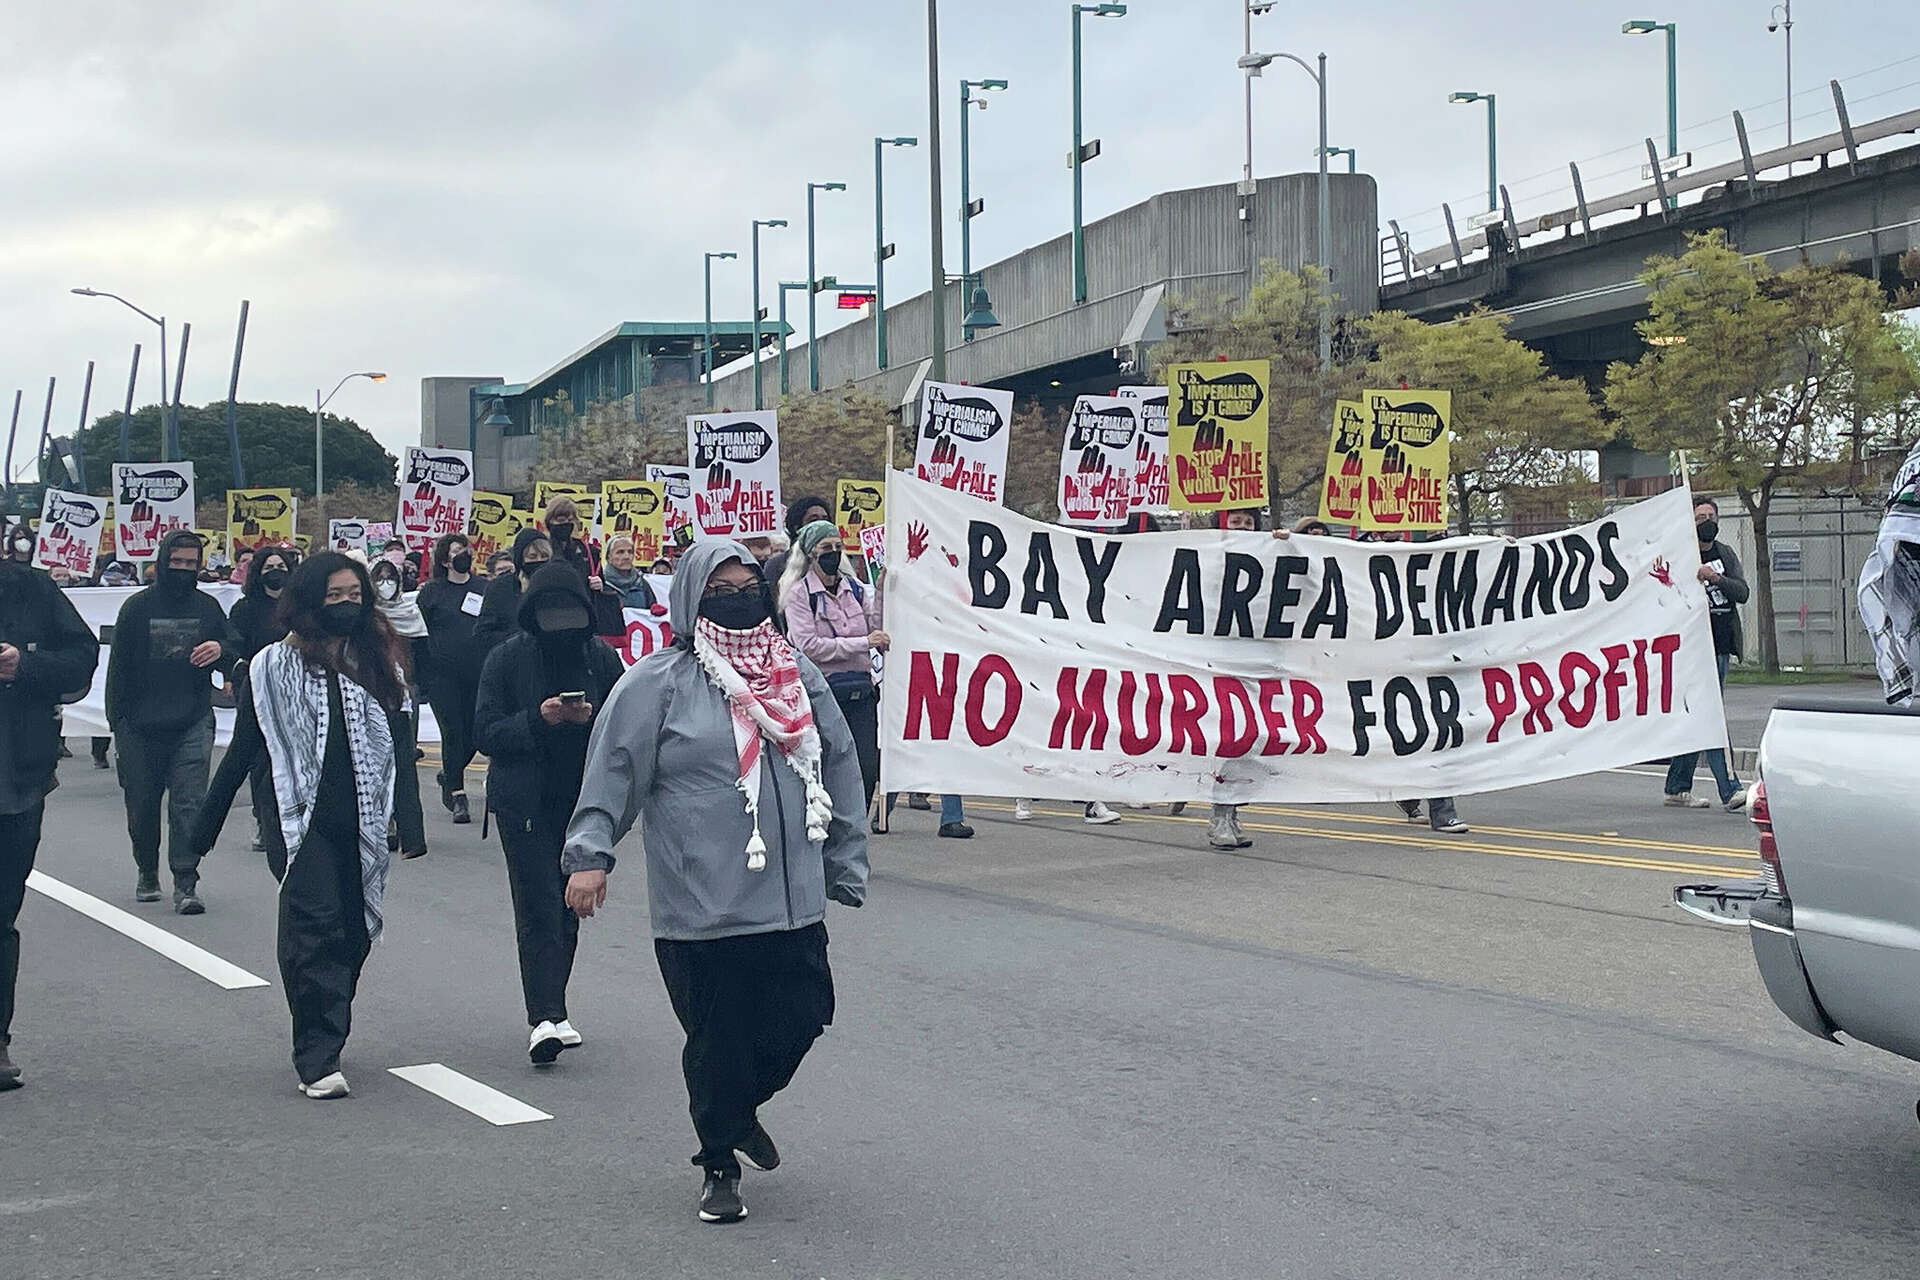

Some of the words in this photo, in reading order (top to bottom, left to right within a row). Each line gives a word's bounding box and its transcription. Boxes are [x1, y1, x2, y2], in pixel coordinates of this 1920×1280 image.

[1179, 371, 1200, 384] U.S.
[1188, 384, 1257, 400] IMPERIALISM
[933, 401, 996, 426] IMPERIALISM
[1192, 400, 1204, 415] IS
[1207, 400, 1215, 416] A
[1218, 400, 1252, 416] CRIME!
[695, 421, 710, 433] U.S.
[934, 417, 943, 430] IS
[944, 418, 952, 432] A
[953, 419, 990, 439] CRIME!
[1378, 410, 1437, 429] IMPERIALISM
[700, 431, 765, 446] IMPERIALISM
[1081, 428, 1090, 442] IS
[1381, 425, 1390, 440] IS
[704, 446, 714, 460] IS
[715, 446, 723, 460] A
[725, 445, 760, 460] CRIME!
[1231, 452, 1262, 476] PALE
[961, 470, 997, 495] PALE
[1183, 476, 1227, 495] WORLD
[1229, 476, 1264, 501] STINE
[1411, 477, 1442, 500] PALE
[741, 490, 774, 511] PALE
[438, 504, 465, 522] PALE
[1408, 500, 1442, 523] STINE
[739, 511, 776, 533] STINE
[967, 519, 1123, 626] BAY
[1152, 547, 1350, 640] AREA
[1367, 521, 1630, 641] DEMANDS
[902, 651, 1022, 747] NO
[1047, 667, 1327, 758] MURDER
[1347, 675, 1464, 758] FOR
[1482, 634, 1681, 743] PROFIT
